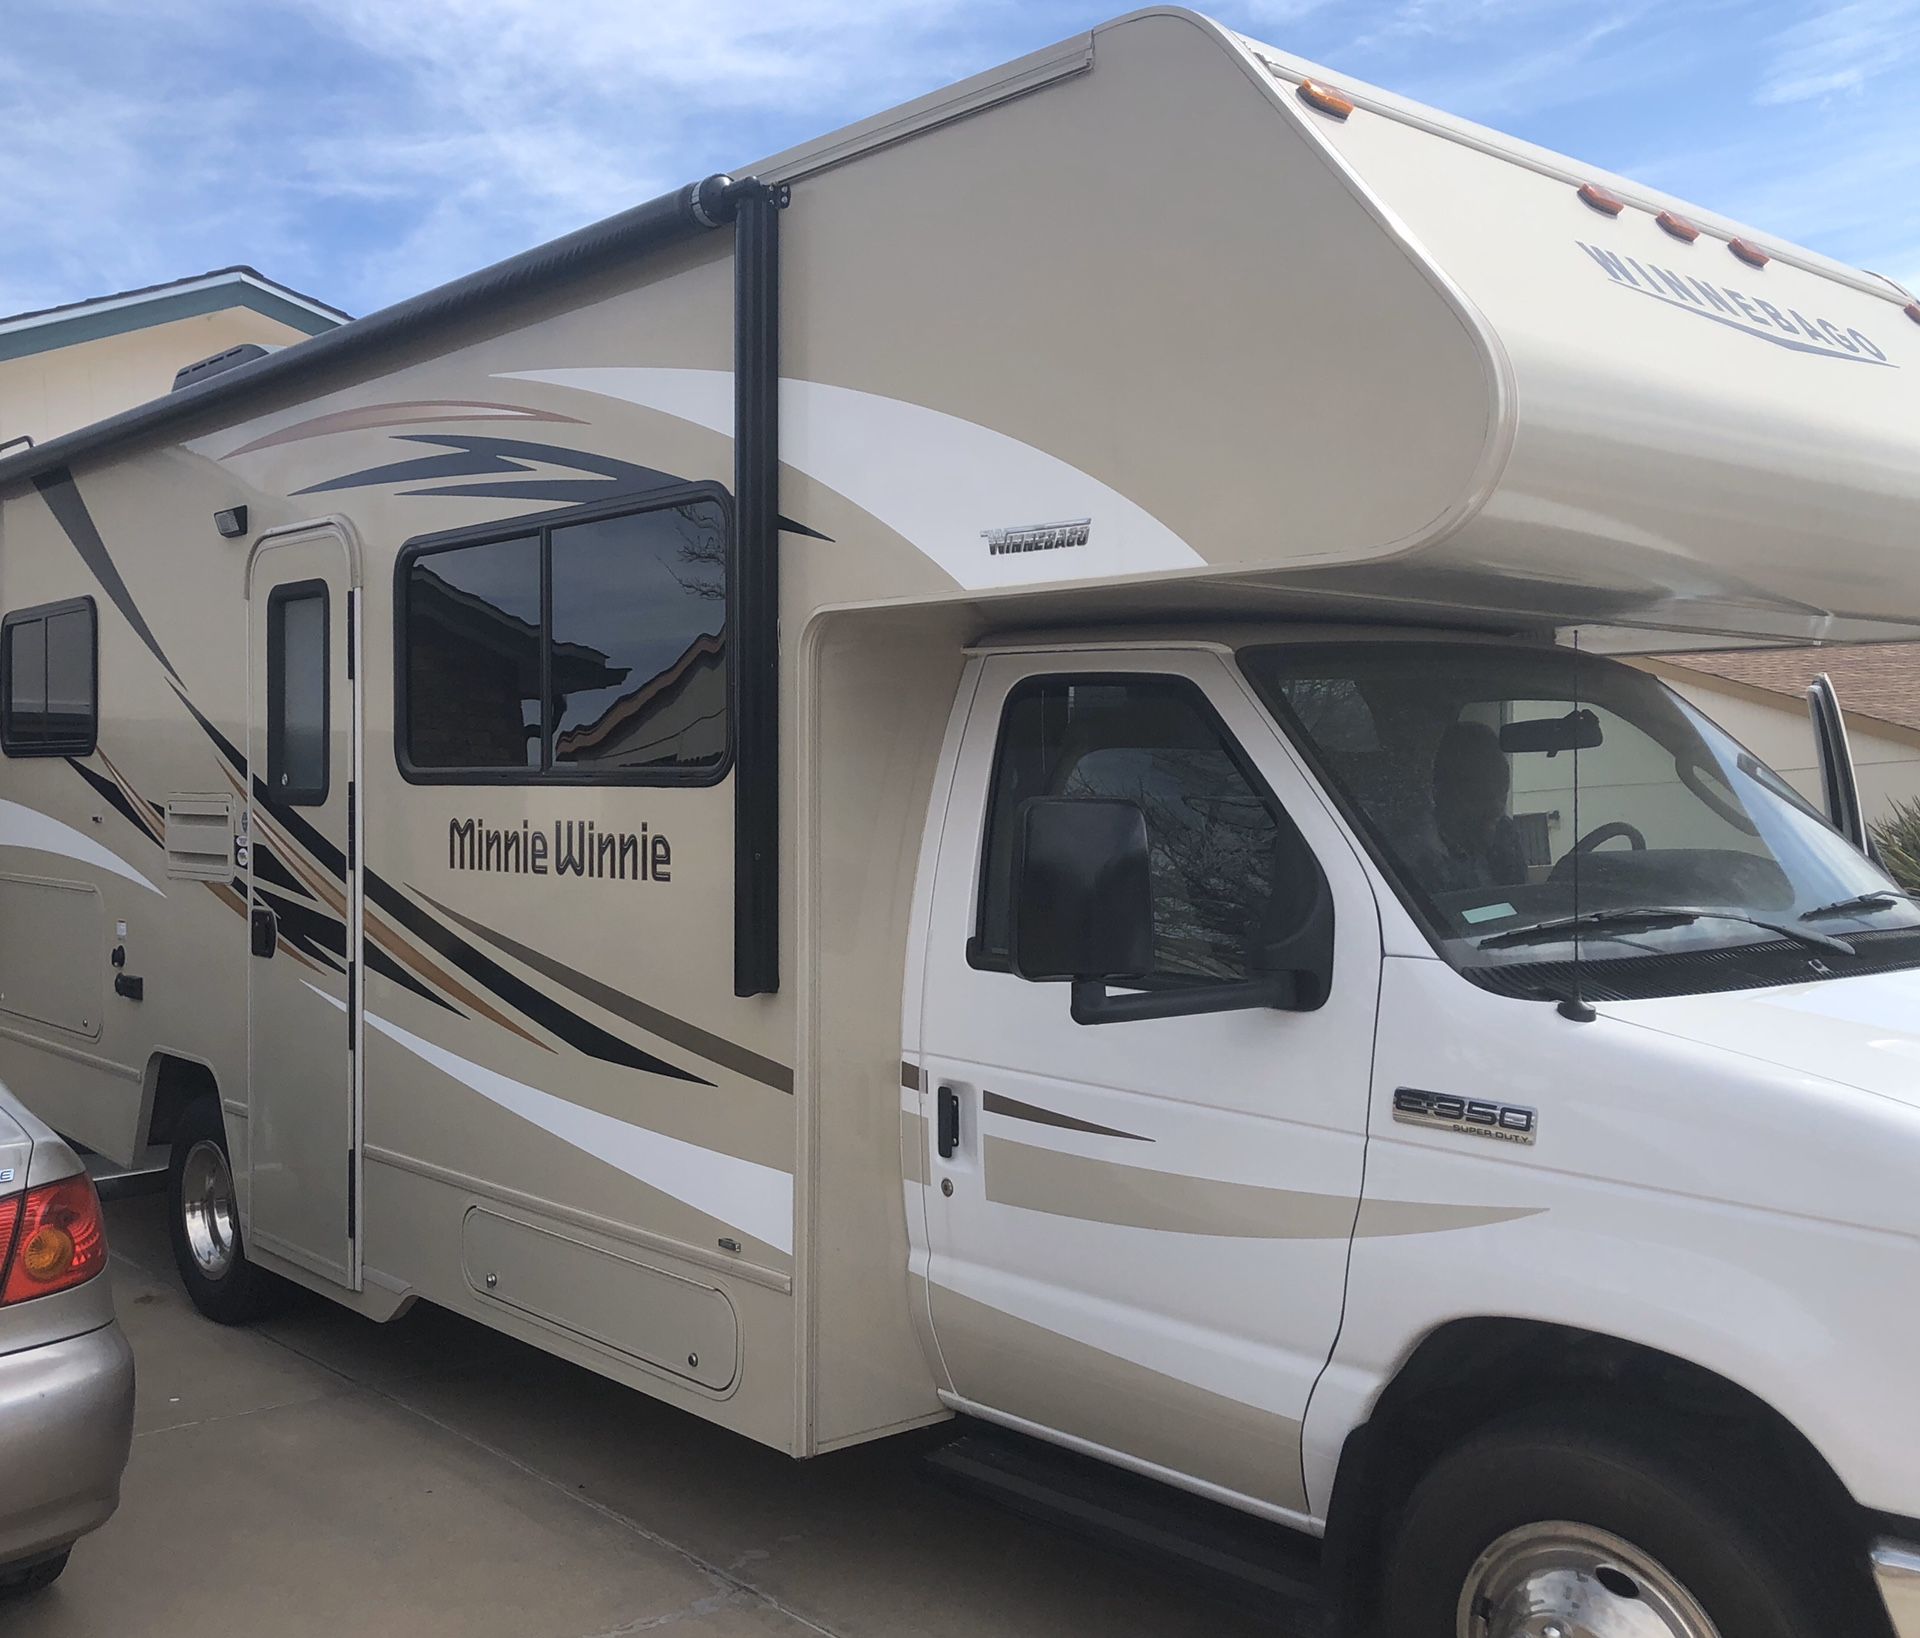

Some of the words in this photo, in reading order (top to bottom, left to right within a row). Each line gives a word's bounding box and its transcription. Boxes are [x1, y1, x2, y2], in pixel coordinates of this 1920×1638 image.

[1575, 240, 1887, 361] WINNEBAGO
[982, 525, 1090, 555] WINNEBAGO
[449, 817, 548, 875] Minnie
[555, 820, 671, 882] Winnie
[1453, 1124, 1492, 1137] SUPER
[1495, 1131, 1529, 1143] DUTY
